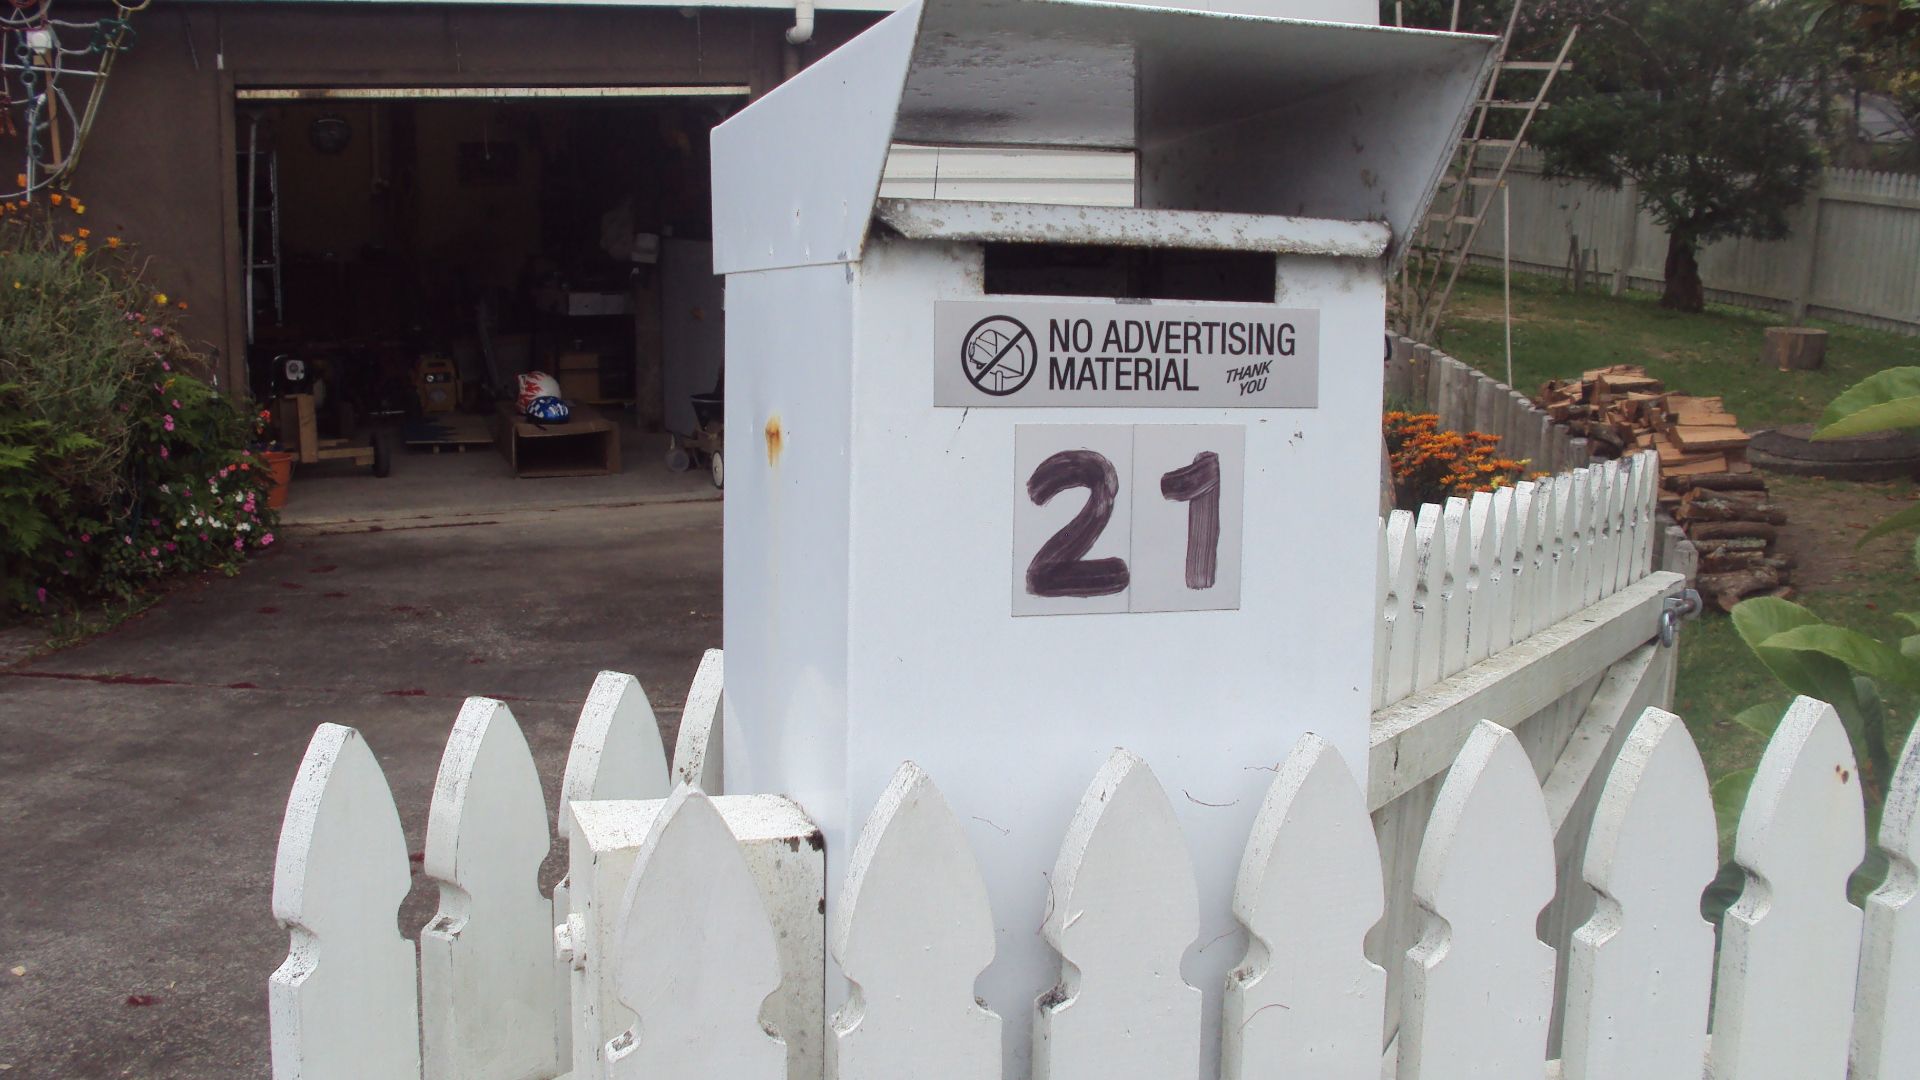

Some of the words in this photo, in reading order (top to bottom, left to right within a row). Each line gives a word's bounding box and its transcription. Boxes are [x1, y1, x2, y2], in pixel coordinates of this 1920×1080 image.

[1049, 318, 1093, 353] NO
[1101, 320, 1296, 356] ADVERTISING
[1049, 357, 1199, 391] MATERIAL
[1225, 360, 1273, 384] THANK
[1238, 377, 1267, 397] YOU
[1025, 449, 1221, 598] 21
